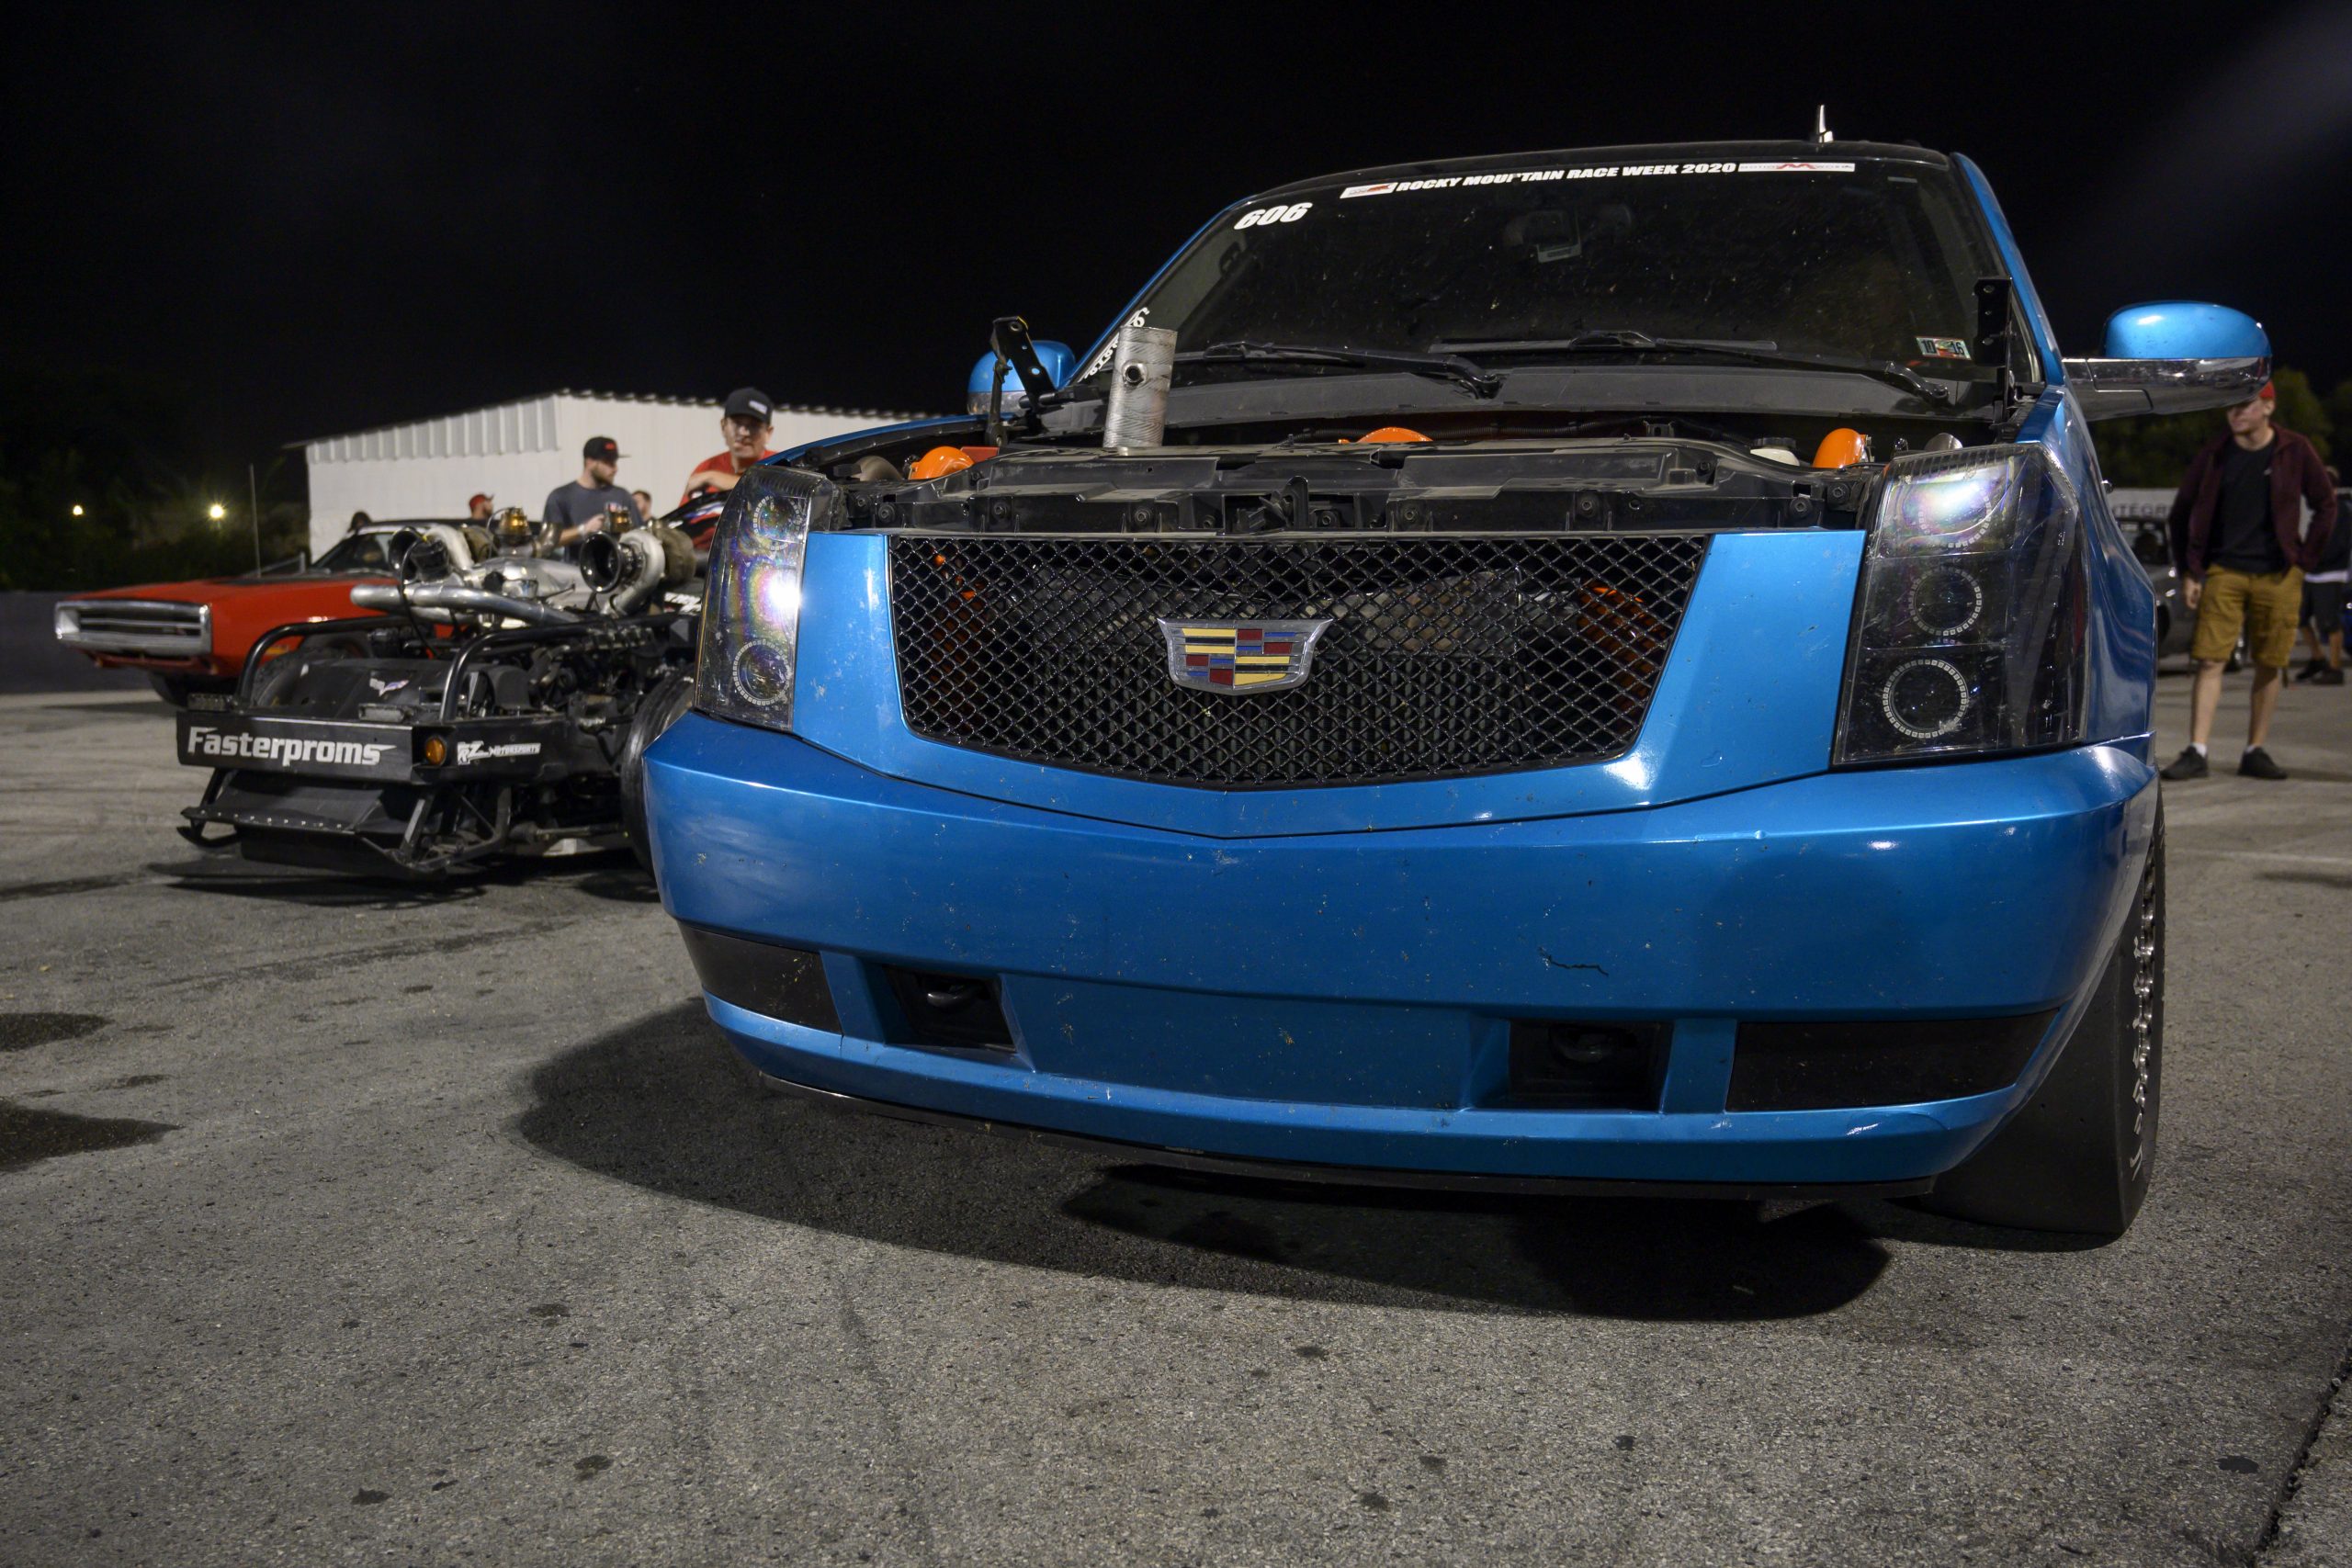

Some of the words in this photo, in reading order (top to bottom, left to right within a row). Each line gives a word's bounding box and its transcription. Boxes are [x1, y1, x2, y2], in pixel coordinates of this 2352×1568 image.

[1396, 178, 1463, 192] ROCKY
[1566, 166, 1621, 180] RACE
[1622, 164, 1680, 176] WEEK
[1680, 163, 1736, 175] 2020
[1233, 201, 1314, 231] 606
[1921, 339, 1938, 355] 10
[187, 726, 398, 767] Fasterproms
